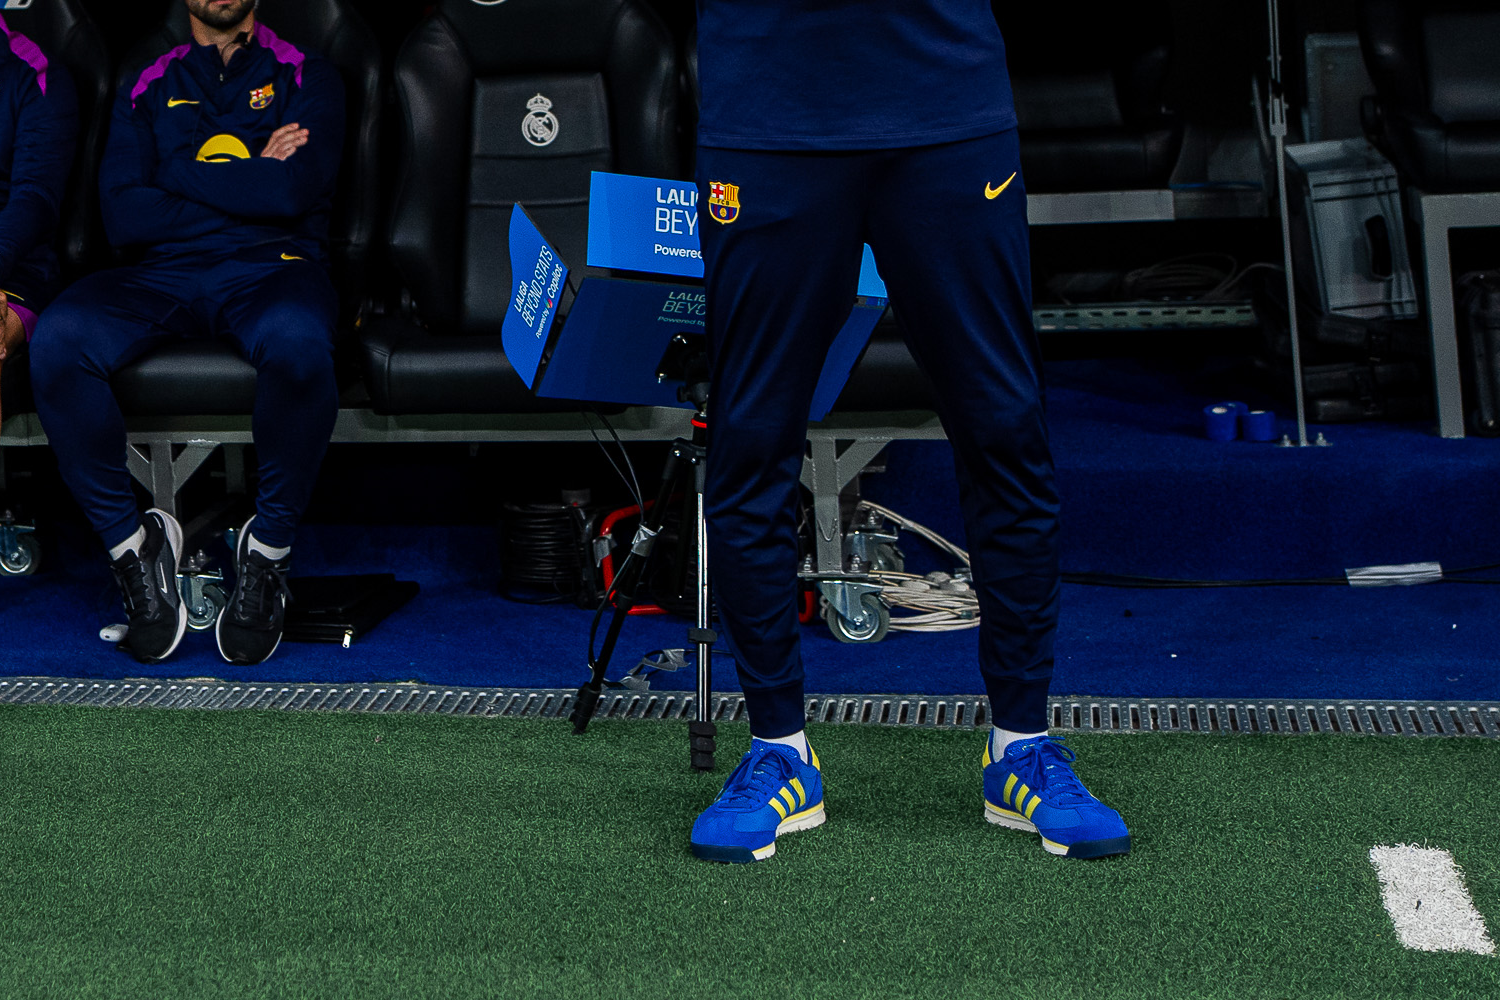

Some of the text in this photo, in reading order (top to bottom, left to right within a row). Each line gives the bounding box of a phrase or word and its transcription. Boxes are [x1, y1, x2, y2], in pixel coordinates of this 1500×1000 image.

[656, 187, 699, 207] LALI
[514, 280, 529, 312] LALIGA
[521, 245, 553, 327] BEYOND STATS
[547, 264, 563, 299] Copilot
